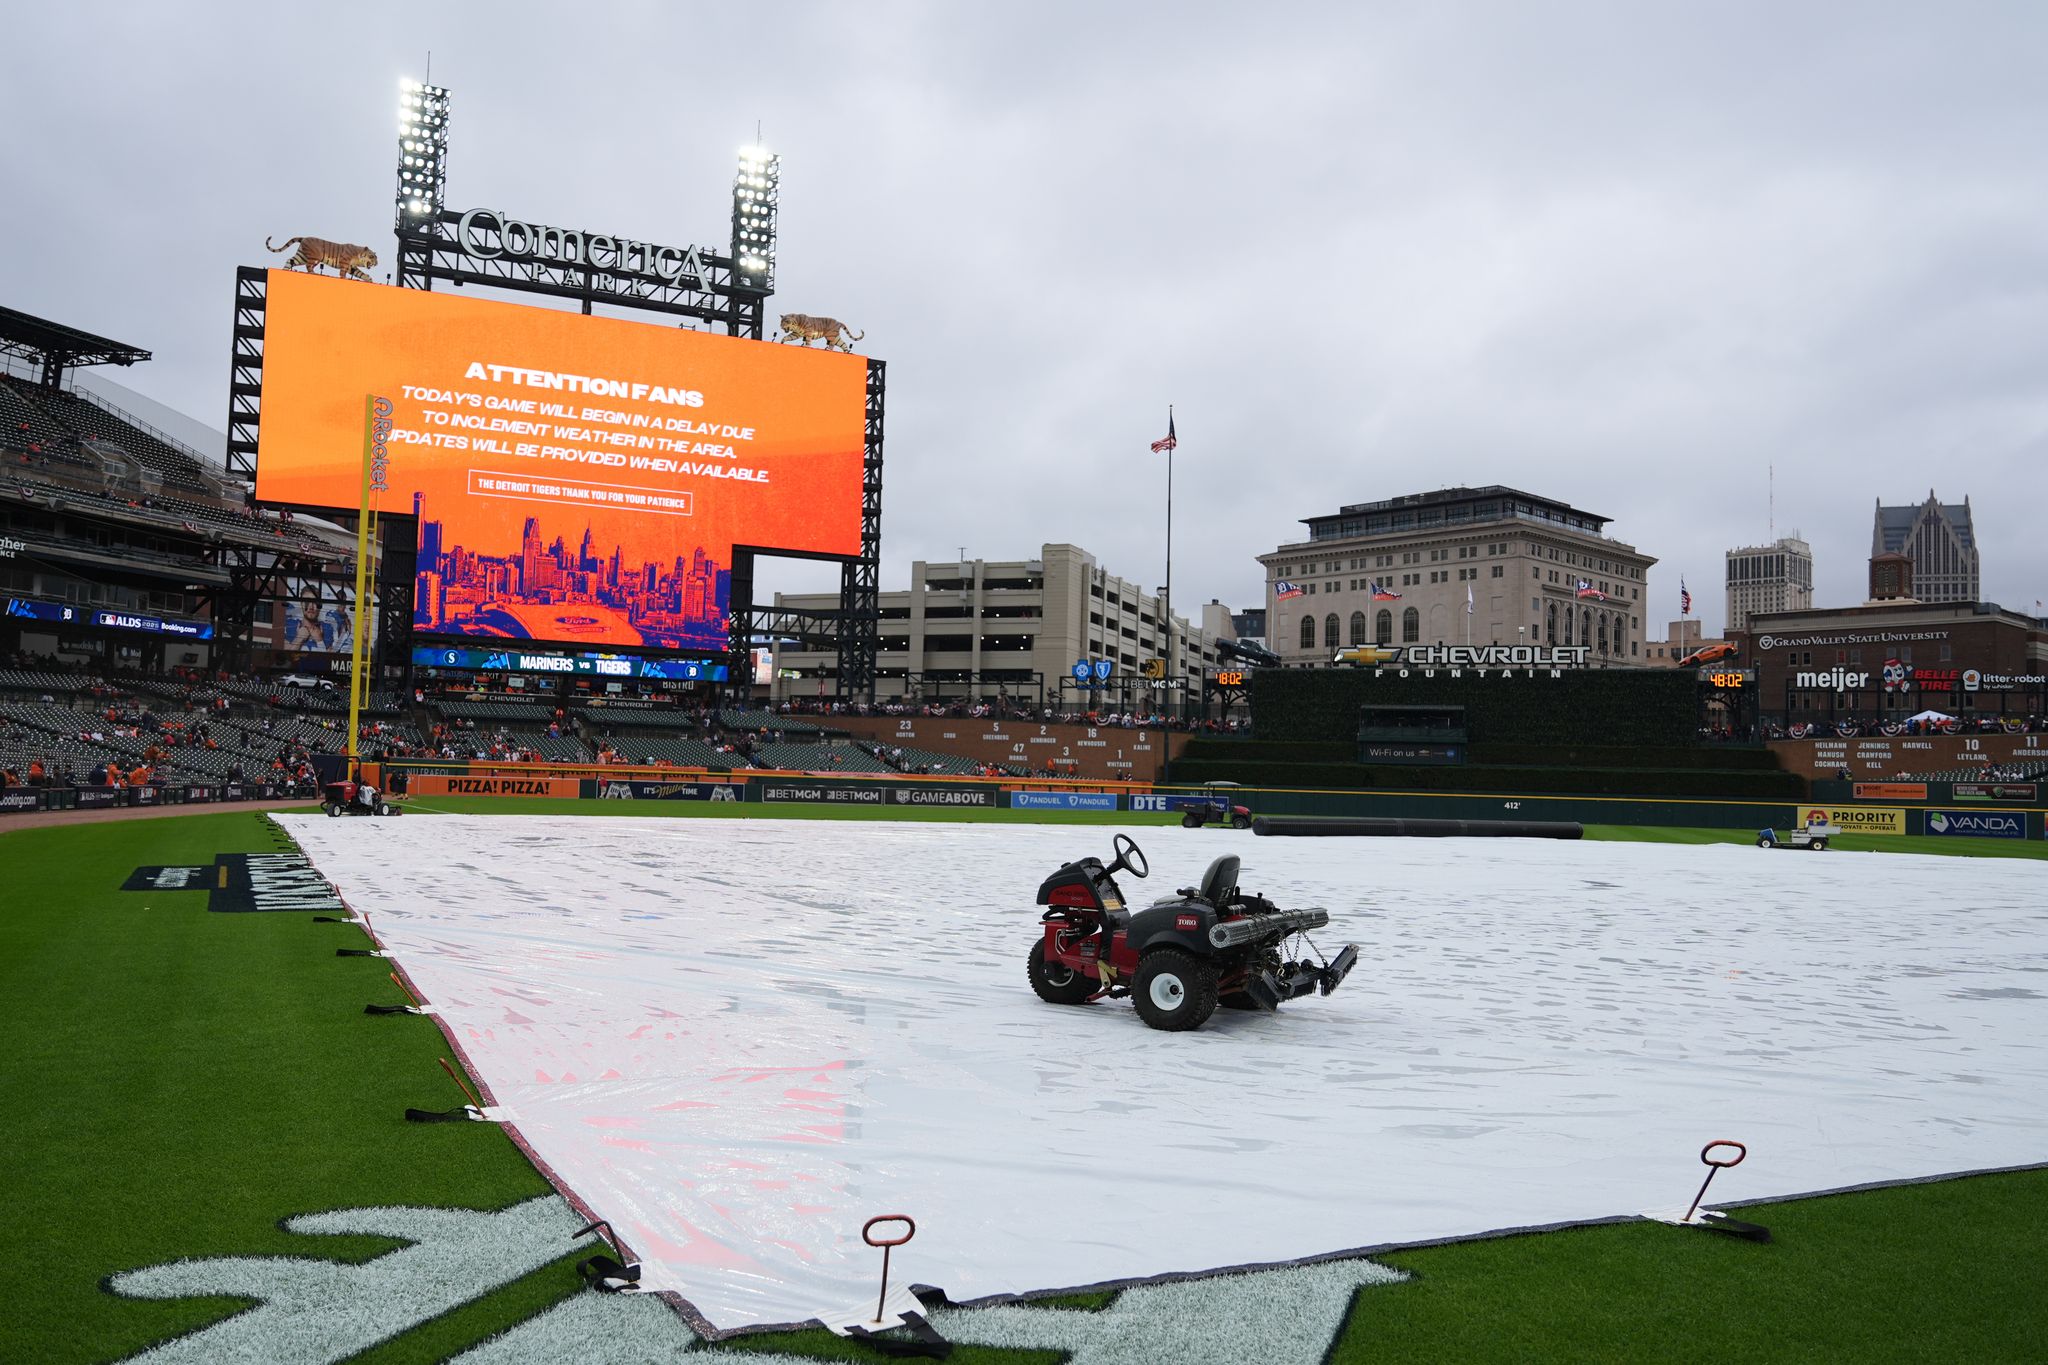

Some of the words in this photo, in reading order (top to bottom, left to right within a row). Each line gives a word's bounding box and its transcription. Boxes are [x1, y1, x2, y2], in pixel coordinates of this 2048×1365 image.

[530, 261, 648, 298] PARK
[464, 361, 629, 399] ATTENTION
[631, 384, 704, 408] FANS
[401, 385, 483, 408] TODAY'S
[484, 396, 538, 414] GAME
[539, 404, 579, 419] WILL
[581, 407, 632, 426] BEGIN
[632, 413, 650, 427] IN
[650, 417, 664, 430] A
[665, 418, 721, 436] DELAY
[721, 425, 756, 441] DUE
[422, 410, 449, 425] TO
[450, 413, 551, 437] INCLEMENT
[553, 426, 637, 447] WEATHER
[637, 436, 655, 450] IN
[656, 437, 690, 454] THE
[690, 442, 738, 459] AREA.
[369, 417, 393, 492] Rocket
[472, 437, 512, 455] WILL
[515, 443, 541, 457] BE
[540, 446, 627, 467] PROVIDED
[629, 456, 679, 473] WHEN
[678, 461, 770, 483] AVAILABLE.
[478, 478, 496, 490] THE
[496, 479, 531, 493] DETROIT
[531, 484, 561, 496] TIGERS
[562, 487, 590, 499] THANK
[590, 489, 608, 501] YOU
[608, 491, 625, 502] FOR
[625, 492, 646, 505] YOUR
[647, 494, 685, 509] PATIENCE
[115, 616, 142, 628] ALDS
[161, 622, 197, 634] Booking.com
[1773, 637, 1811, 647] GRAND
[1810, 635, 1847, 645] VALLEY
[1848, 634, 1880, 644] STATE
[1881, 631, 1949, 642] UNIVERSITY
[1408, 646, 1591, 664] CHEVROLET
[520, 655, 574, 671] MARINERS
[579, 661, 591, 669] vs
[595, 659, 632, 675] TIGERS
[1375, 669, 1562, 678] FOUNTAIN
[1914, 669, 1960, 679] BELLE
[1130, 680, 1178, 689] BETMGM
[1710, 673, 1743, 687] 48:02
[1796, 667, 1869, 693] meijer
[1920, 681, 1953, 691] TIRE
[489, 695, 536, 703] CHEVROLET
[609, 701, 654, 709] CHEVROLET
[900, 720, 912, 730] 23
[993, 722, 999, 732] 5
[1040, 725, 1047, 735] 2
[1087, 728, 1097, 738] 16
[1139, 732, 1146, 742] 6
[1964, 739, 1980, 751] 10
[2025, 736, 2038, 748] 11
[1012, 743, 1025, 753] 47
[1063, 746, 1069, 756] 3
[1369, 748, 1392, 757] Wi-Fi
[1117, 749, 1122, 759] 1
[448, 779, 497, 794] PIZZA!
[501, 780, 550, 795] PIZZA!
[643, 784, 656, 795] IT'S
[655, 783, 687, 799] Miller
[682, 787, 699, 796] TIME
[775, 789, 821, 800] BETMGM
[835, 790, 879, 801] BETMGM
[912, 791, 985, 804] GAMEABOVE
[1029, 796, 1061, 805] FANDUEL
[1078, 797, 1110, 806] FANDUEL
[1133, 796, 1166, 811] DTE
[1504, 801, 1521, 810] 412'
[1832, 811, 1896, 823] PRIORITY
[1950, 816, 2019, 830] VANDA
[1178, 918, 1197, 926] TORO
